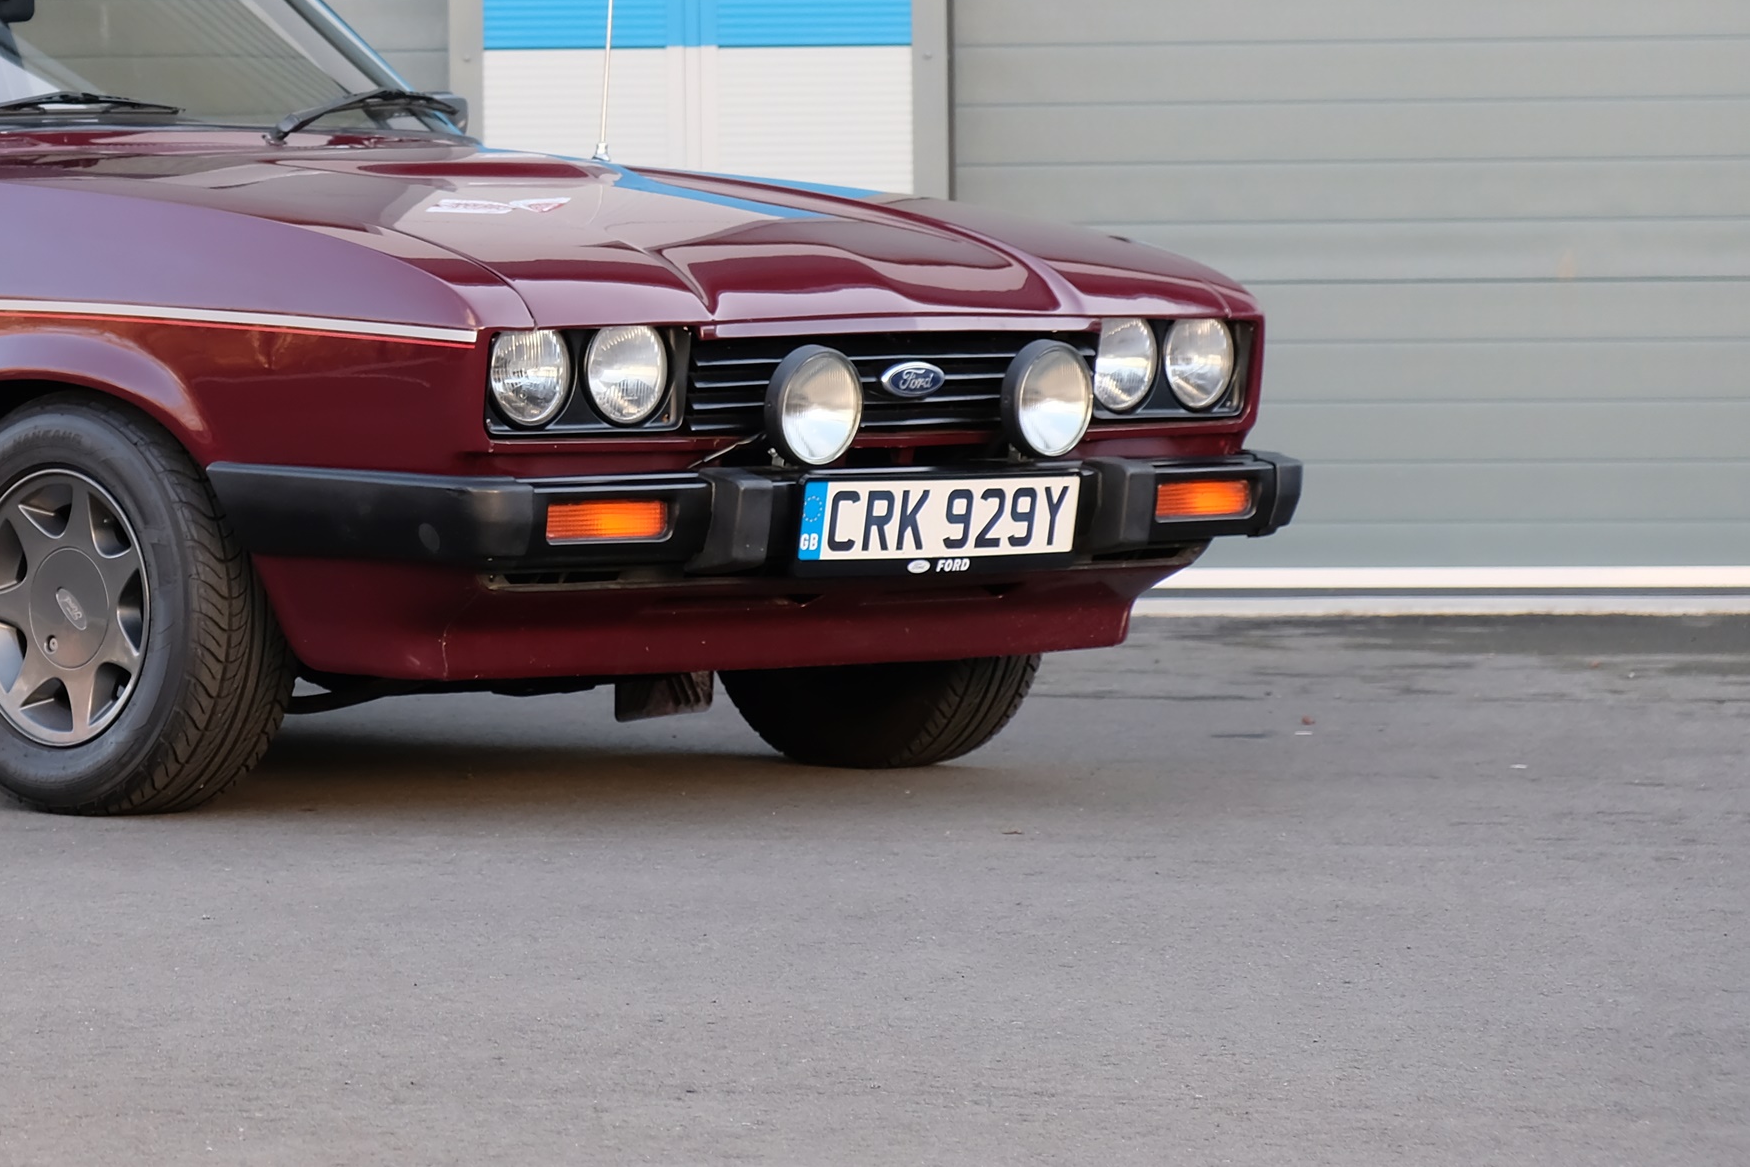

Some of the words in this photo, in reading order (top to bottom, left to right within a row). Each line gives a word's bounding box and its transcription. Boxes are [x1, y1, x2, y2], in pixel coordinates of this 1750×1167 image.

[899, 369, 935, 390] Ford
[827, 489, 931, 552] CRK
[942, 485, 1070, 550] 929Y
[800, 533, 818, 551] GB
[935, 558, 970, 573] FORD
